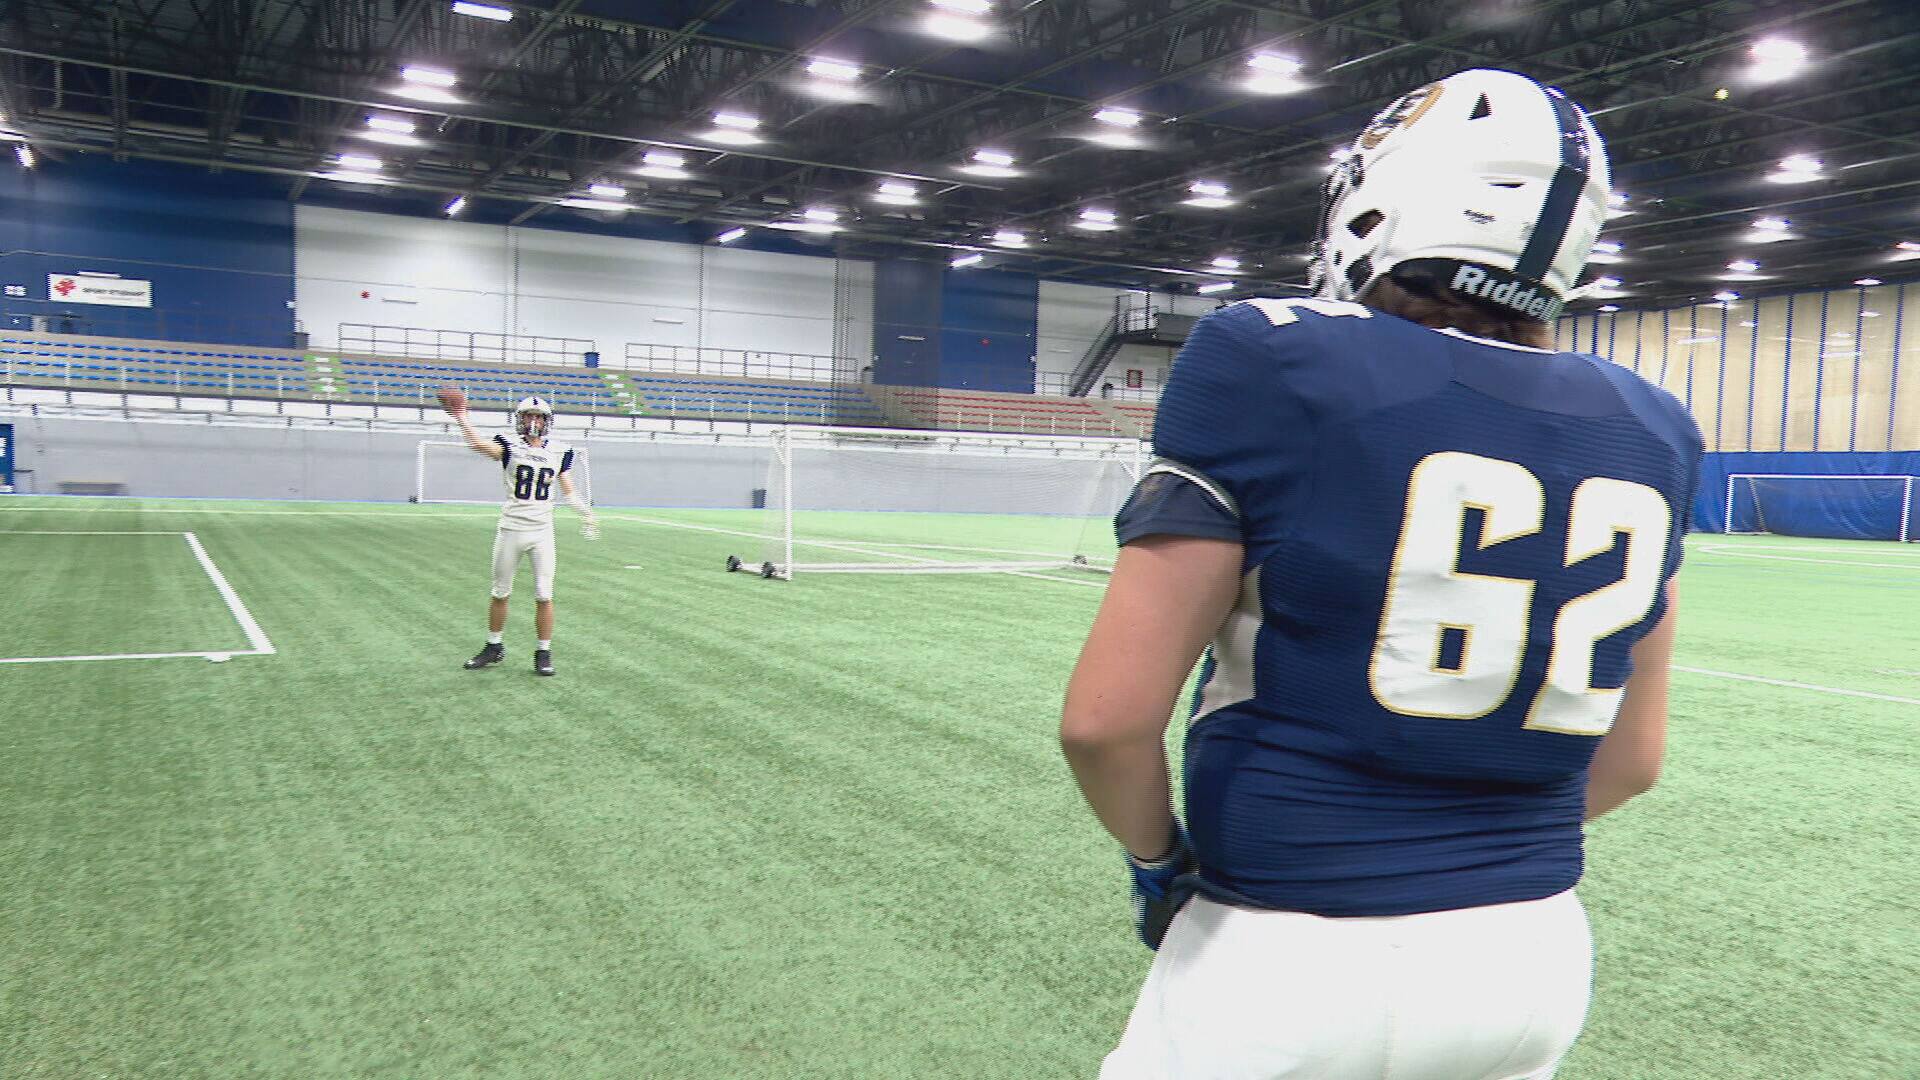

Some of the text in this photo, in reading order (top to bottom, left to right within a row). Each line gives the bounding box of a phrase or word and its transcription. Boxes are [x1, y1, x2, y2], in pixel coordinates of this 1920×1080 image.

[1451, 263, 1561, 321] Riddell
[514, 464, 555, 500] 86
[1366, 450, 1672, 737] 62
